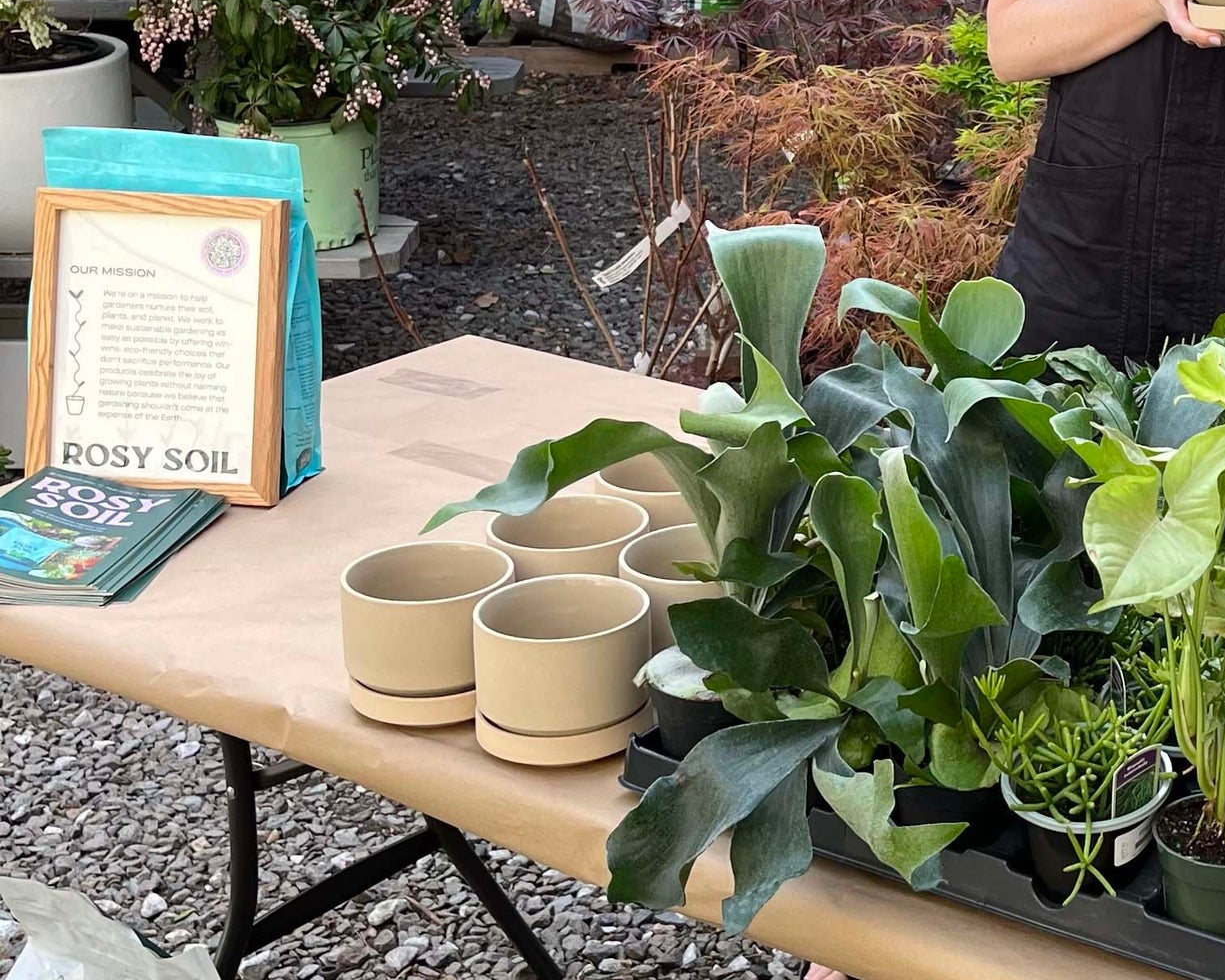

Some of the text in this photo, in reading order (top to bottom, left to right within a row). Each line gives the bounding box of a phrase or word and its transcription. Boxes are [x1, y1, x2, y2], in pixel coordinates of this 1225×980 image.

[70, 265, 157, 278] OUR MISSION
[180, 293, 188, 301] to
[178, 370, 192, 378] the
[62, 441, 238, 474] ROSY SOIL
[31, 475, 172, 513] ROSY
[25, 491, 134, 527] SOIL
